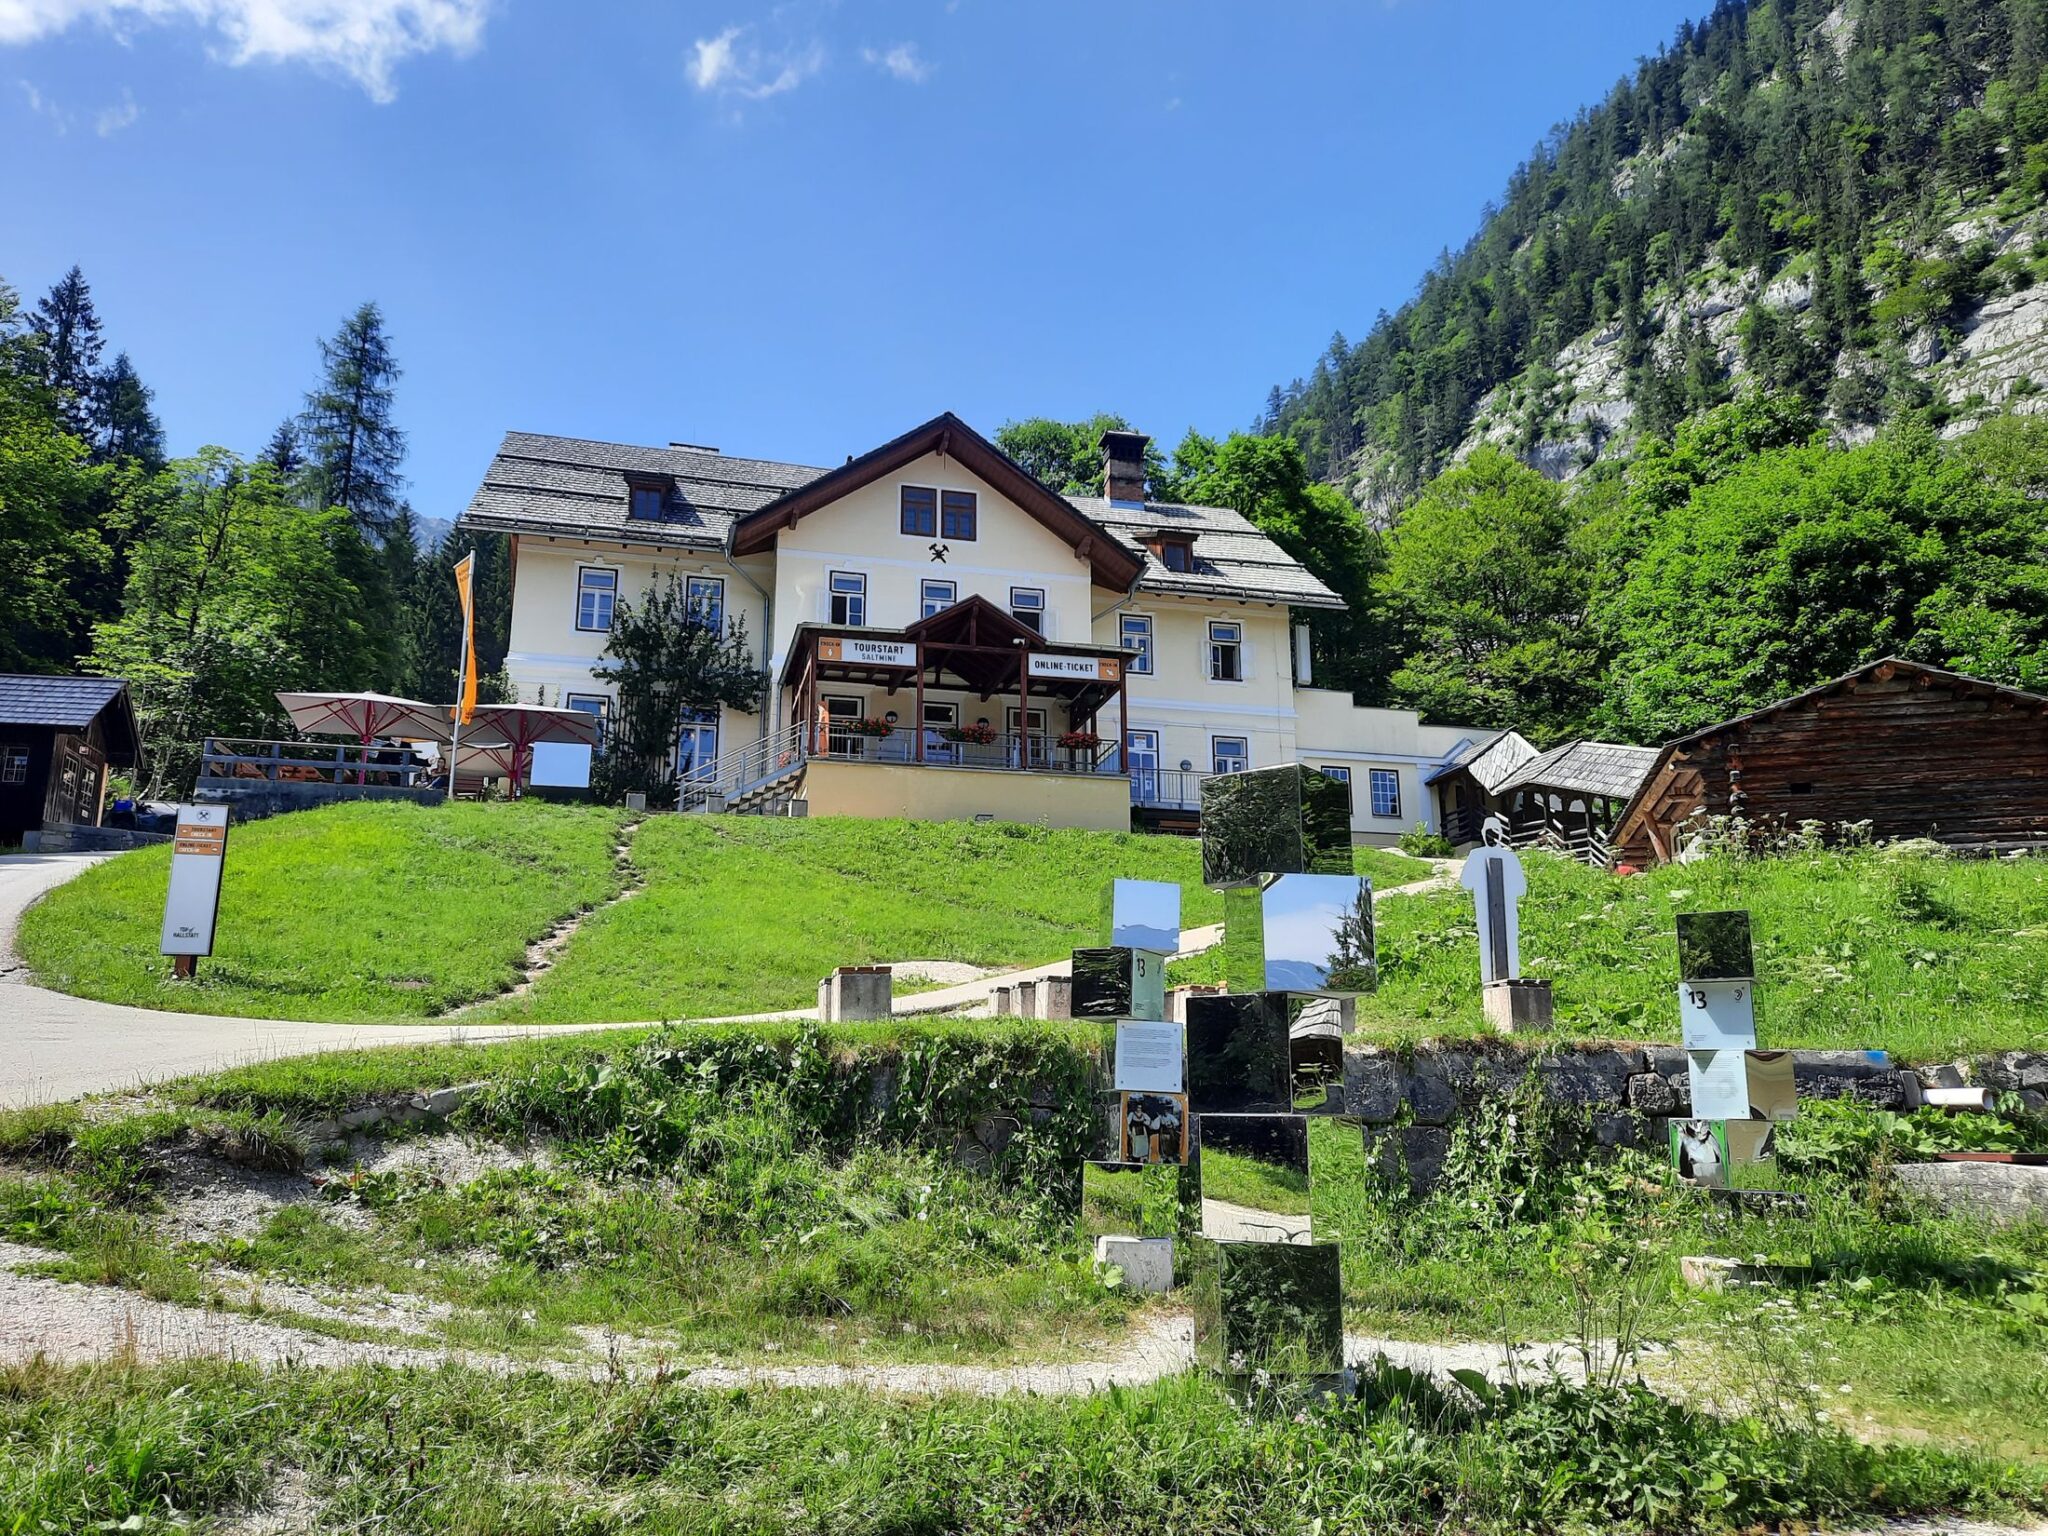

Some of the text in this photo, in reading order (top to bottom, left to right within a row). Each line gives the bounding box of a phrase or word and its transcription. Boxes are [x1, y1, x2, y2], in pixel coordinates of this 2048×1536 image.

[854, 642, 904, 655] TOURSTART
[861, 652, 896, 663] SALTMINE
[1034, 660, 1094, 673] ONLINE-TICKET
[1136, 958, 1146, 978] 13
[1688, 990, 1707, 1010] 13
